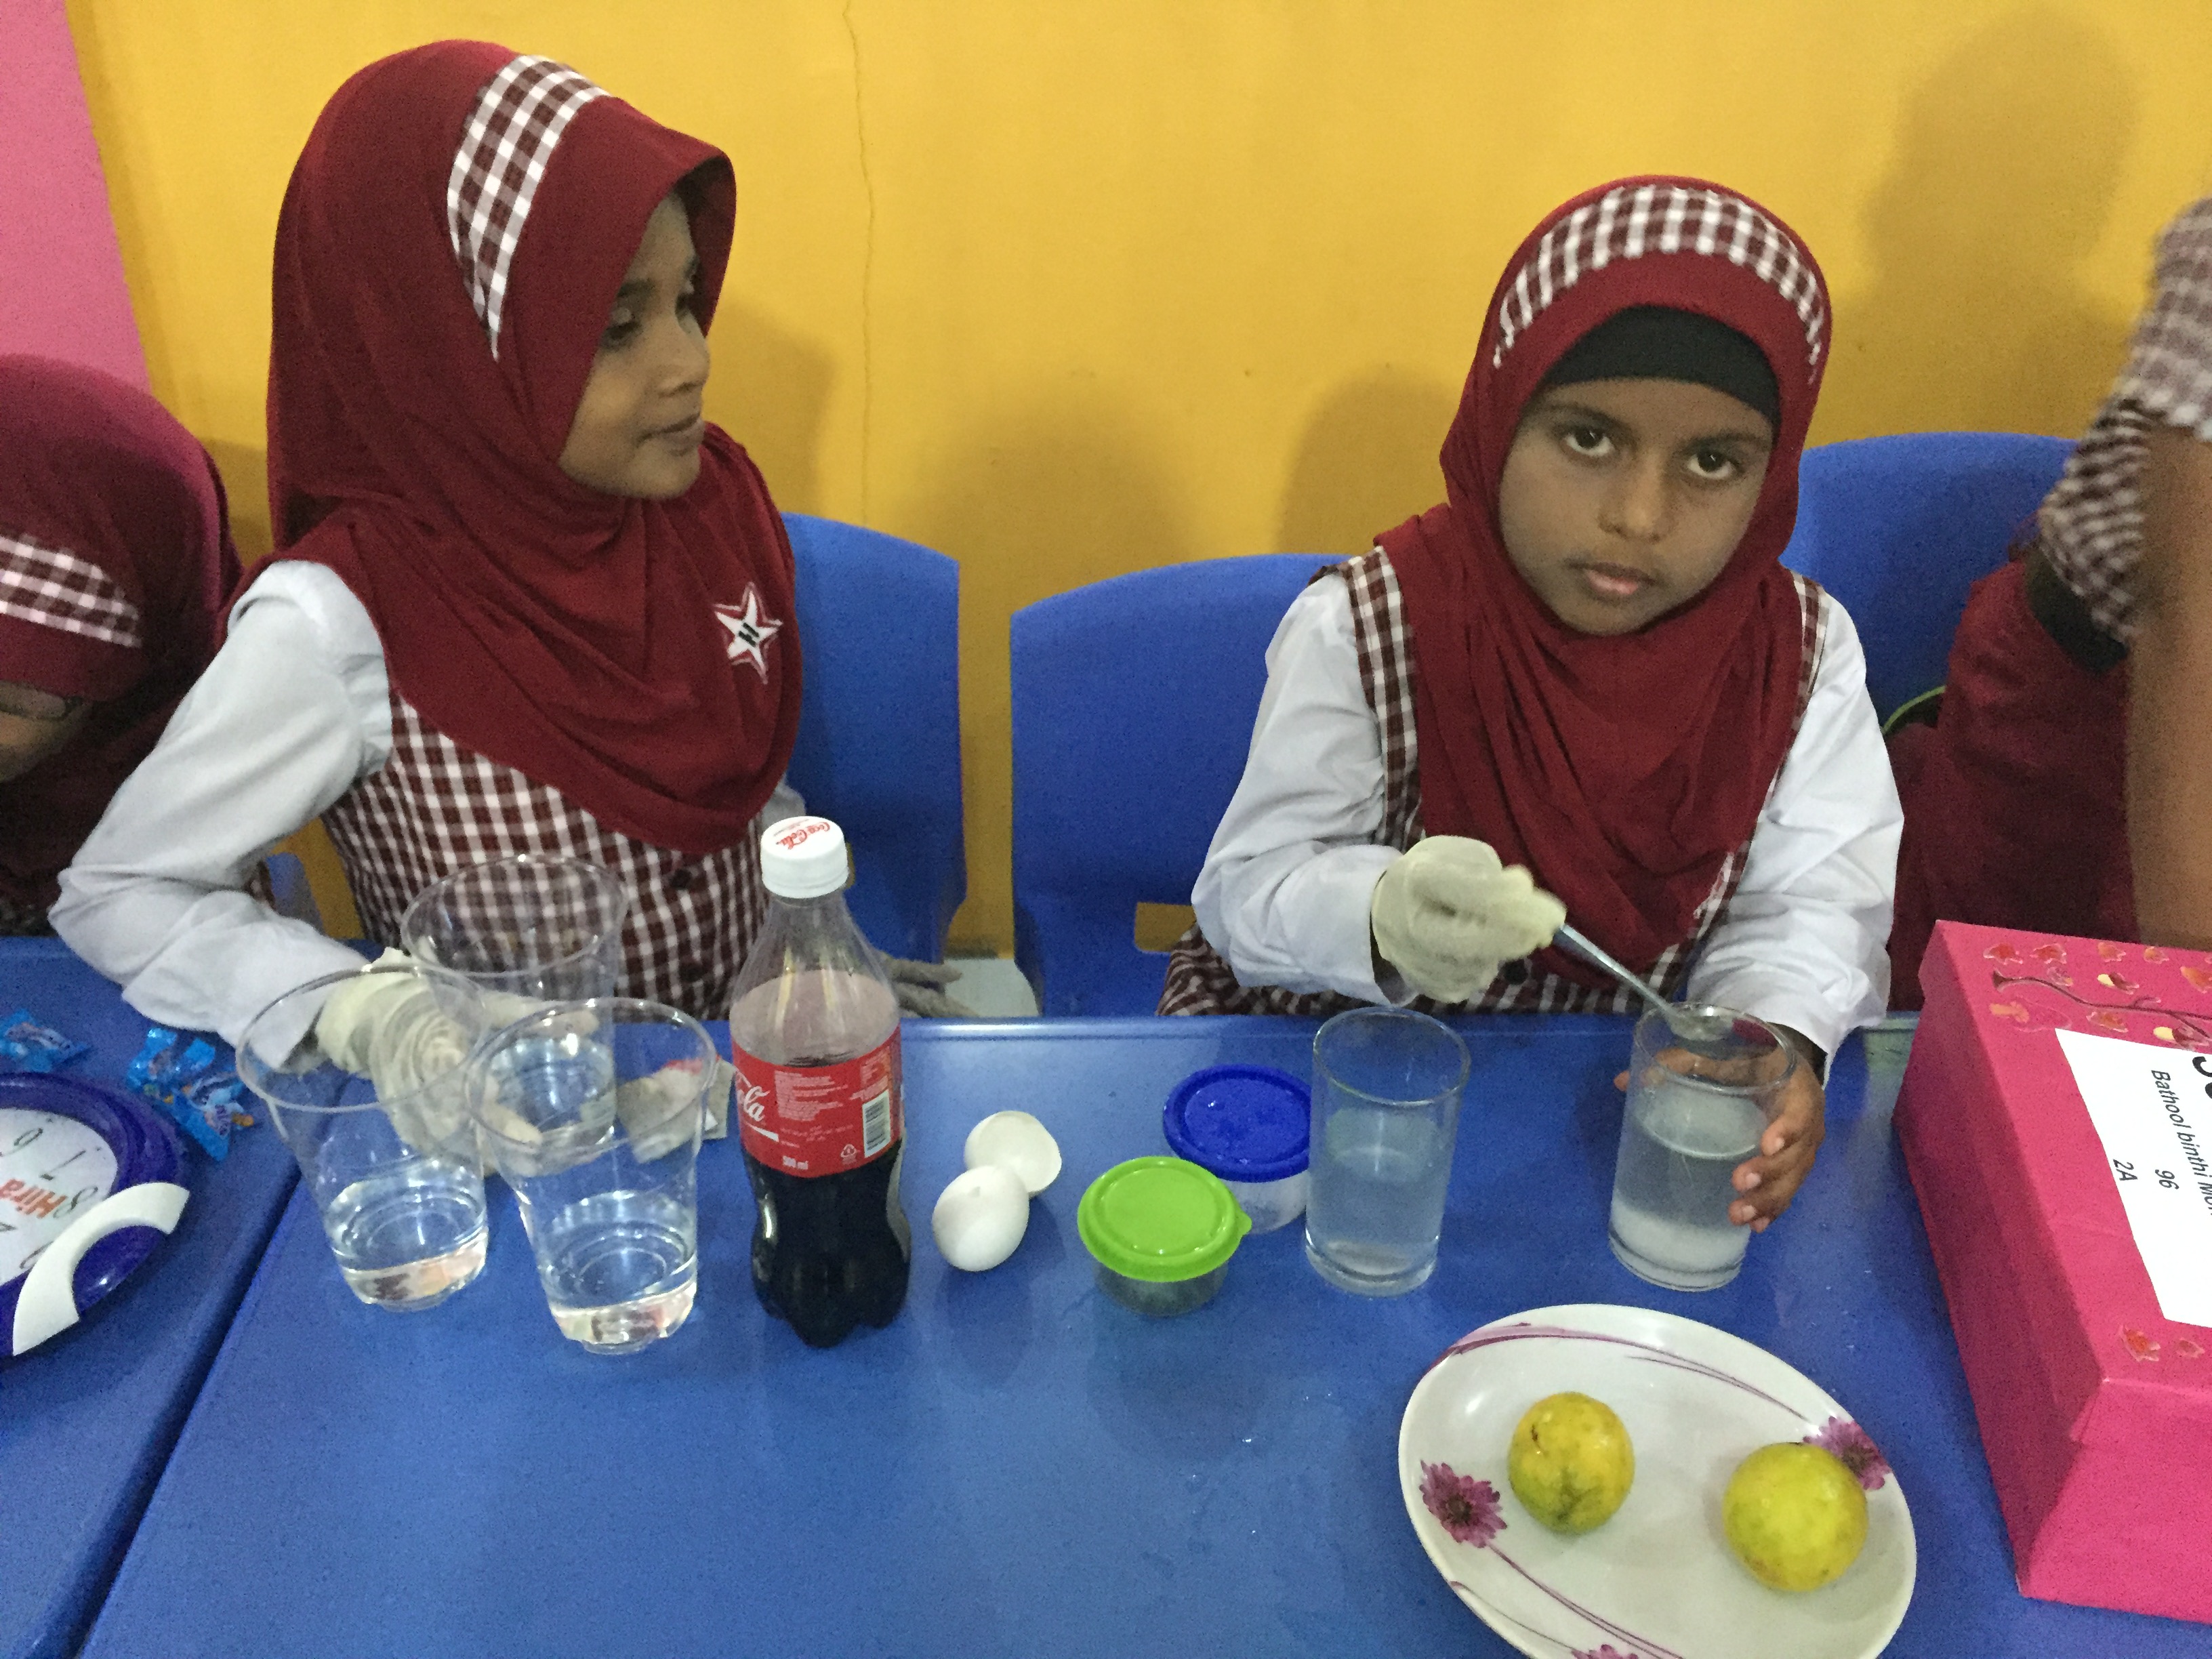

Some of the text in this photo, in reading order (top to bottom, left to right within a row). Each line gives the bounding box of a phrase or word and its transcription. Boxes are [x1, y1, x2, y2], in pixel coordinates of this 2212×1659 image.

[2151, 1069, 2192, 1128] Bathool
[2177, 1132, 2212, 1176] binthi
[2113, 1159, 2138, 1181] 2A
[2155, 1169, 2179, 1189] 96
